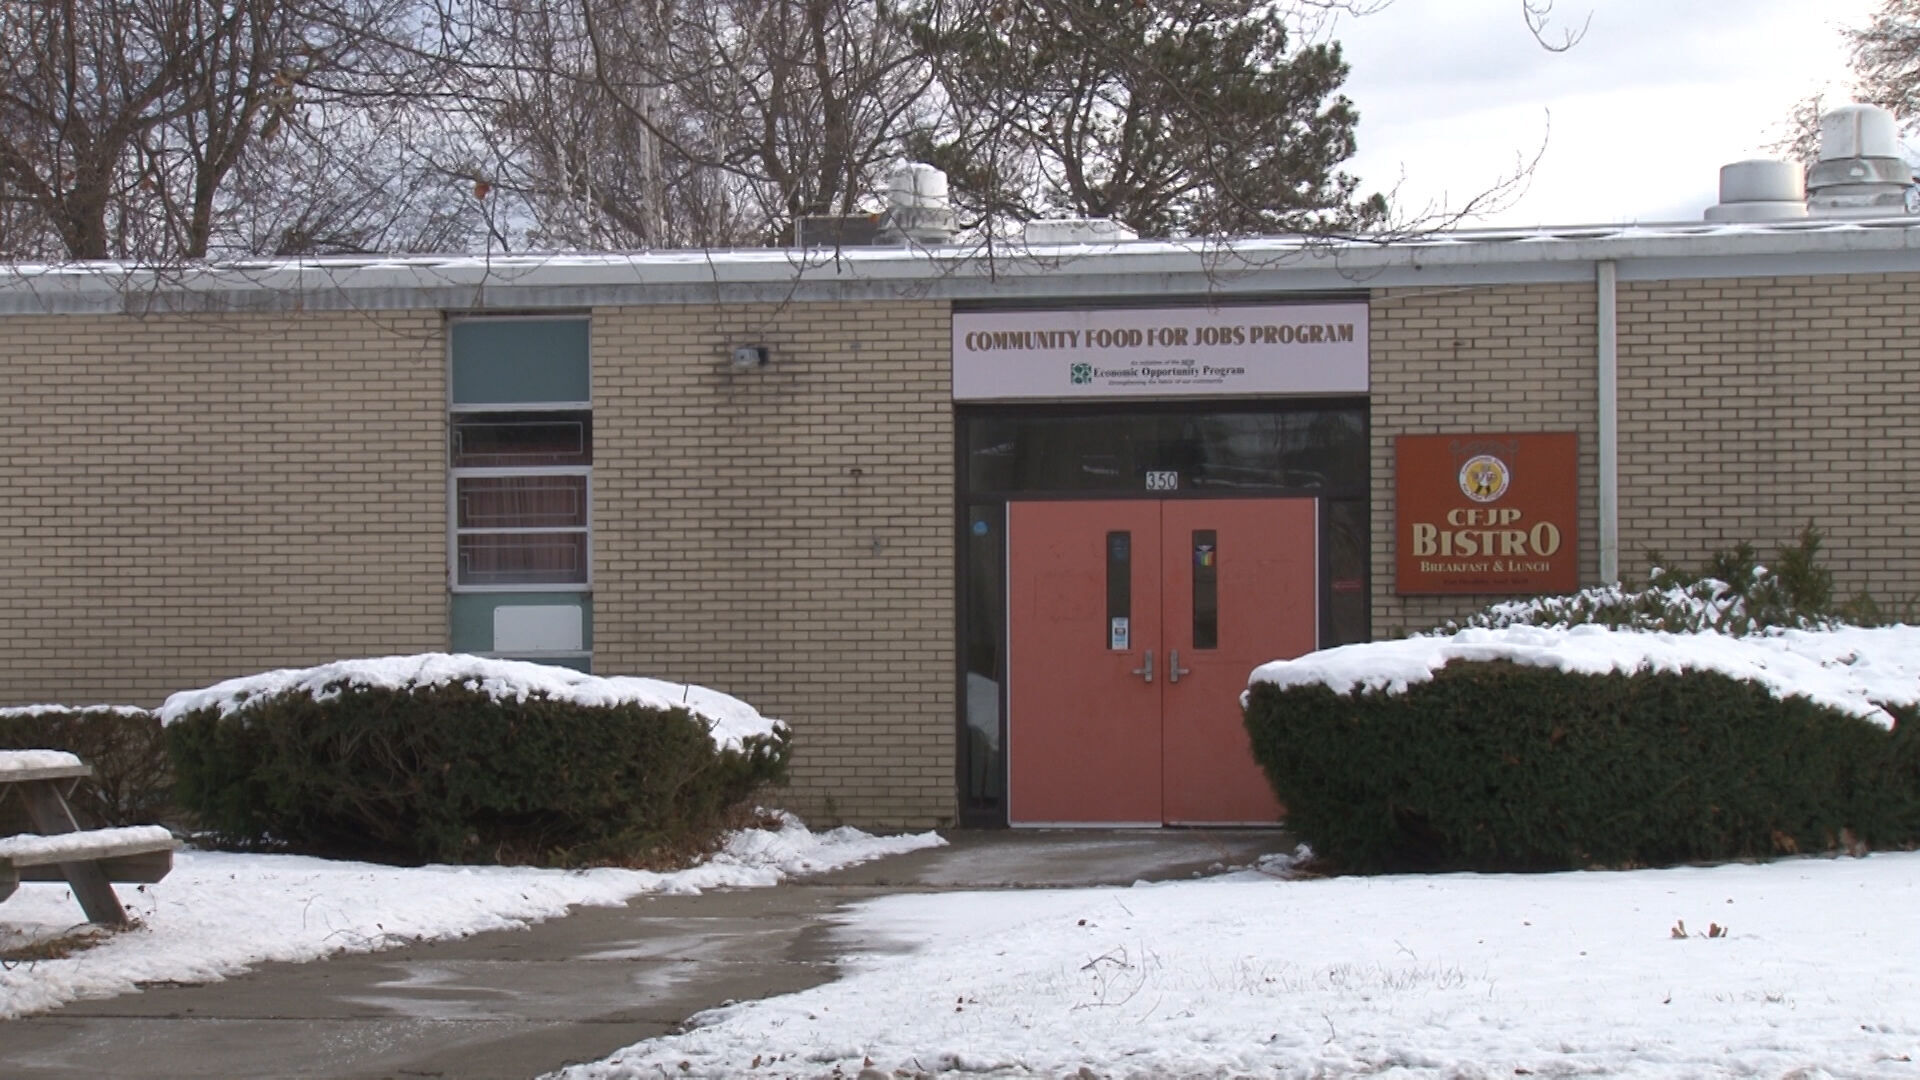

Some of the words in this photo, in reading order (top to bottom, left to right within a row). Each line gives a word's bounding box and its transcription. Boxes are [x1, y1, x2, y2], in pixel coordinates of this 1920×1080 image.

[965, 329, 1081, 352] COMMUNITY
[1085, 328, 1143, 348] FOOD
[1147, 326, 1189, 347] FOR
[1192, 325, 1246, 347] JOBS
[1250, 323, 1354, 345] PROGRAM
[1093, 367, 1138, 378] Economic
[1142, 366, 1199, 379] Opportunity
[1203, 365, 1245, 378] Program
[1146, 471, 1177, 490] 350
[1447, 508, 1522, 527] CFJP
[1412, 521, 1561, 557] BISTRO
[1420, 561, 1489, 573] BREAKFAST
[1492, 560, 1505, 573] &
[1508, 560, 1550, 573] LUNCH
